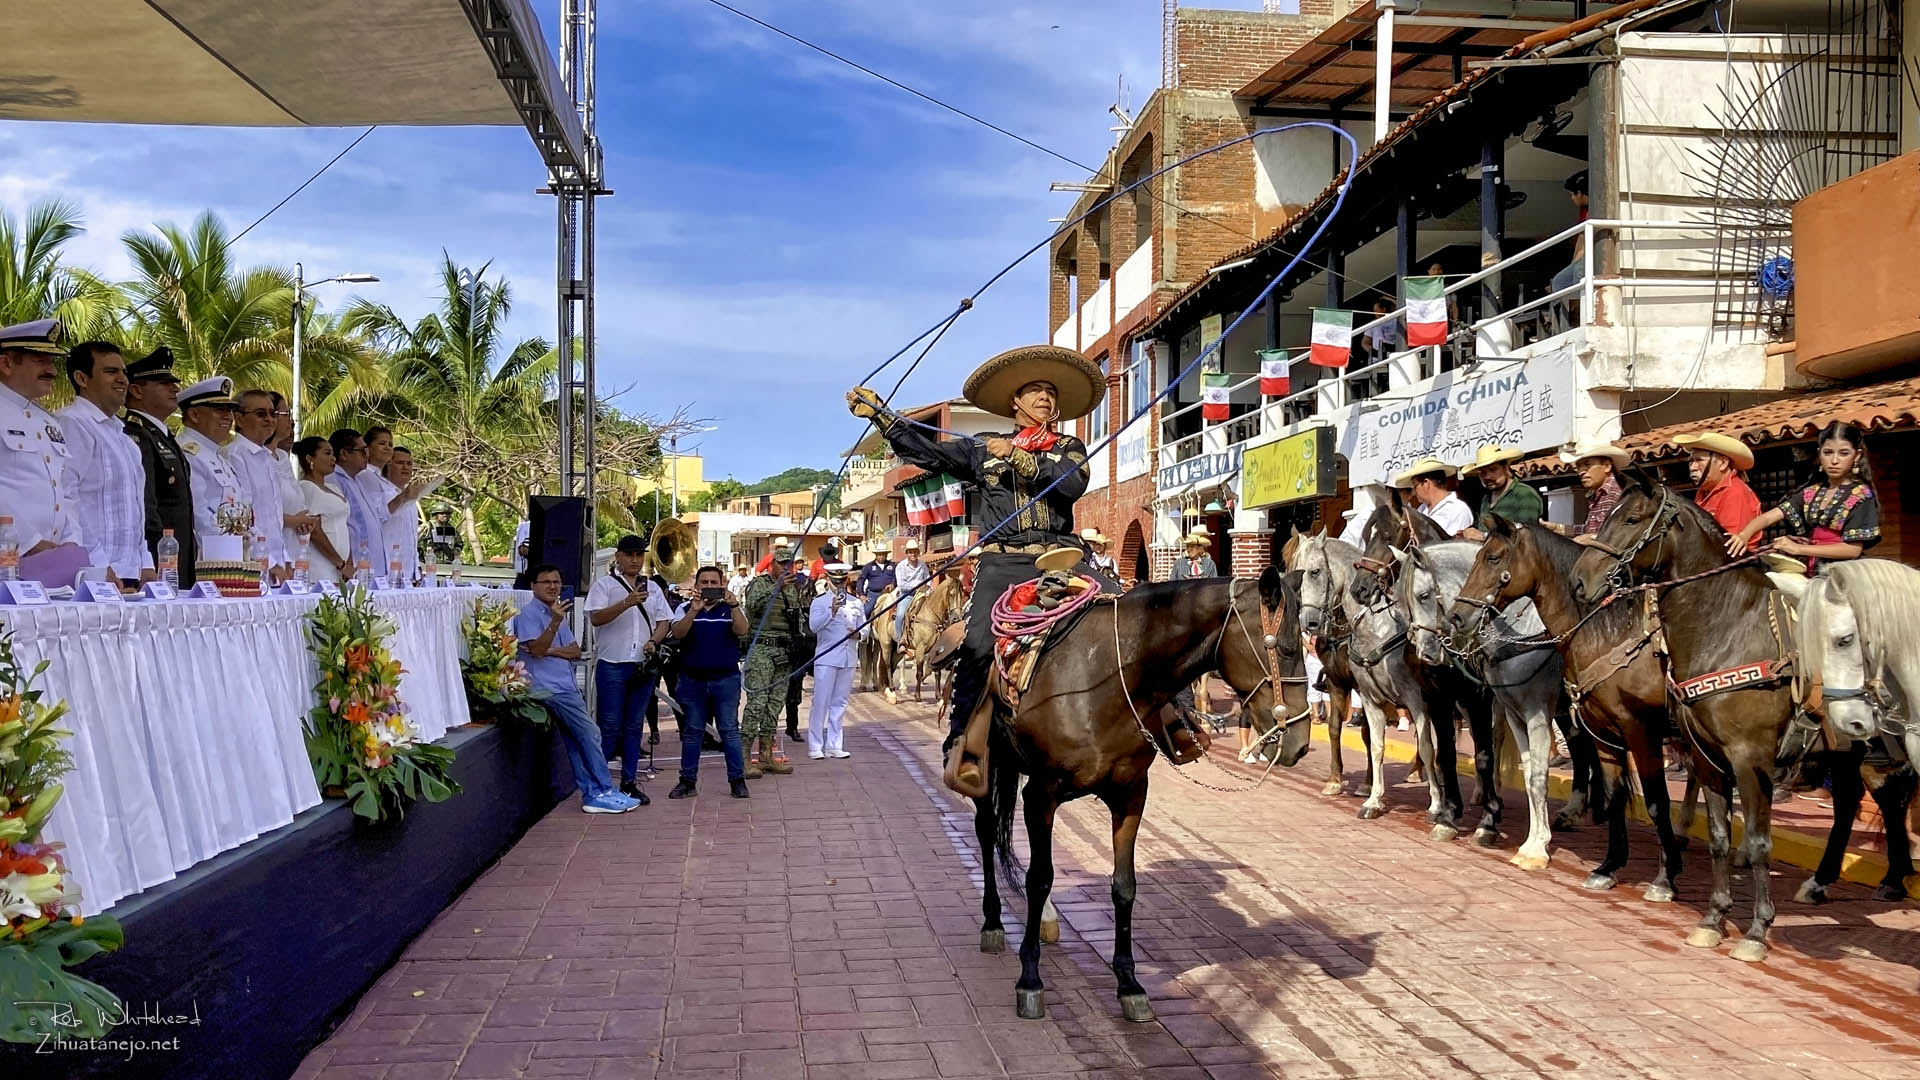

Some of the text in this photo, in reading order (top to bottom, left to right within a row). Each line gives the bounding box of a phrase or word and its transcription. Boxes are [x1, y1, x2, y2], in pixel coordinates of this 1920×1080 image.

[1378, 397, 1449, 428] COMIDA
[1456, 371, 1529, 405] CHINA
[1391, 432, 1442, 459] CHANG
[1446, 415, 1506, 446] SHENG
[851, 461, 886, 470] HOTEL
